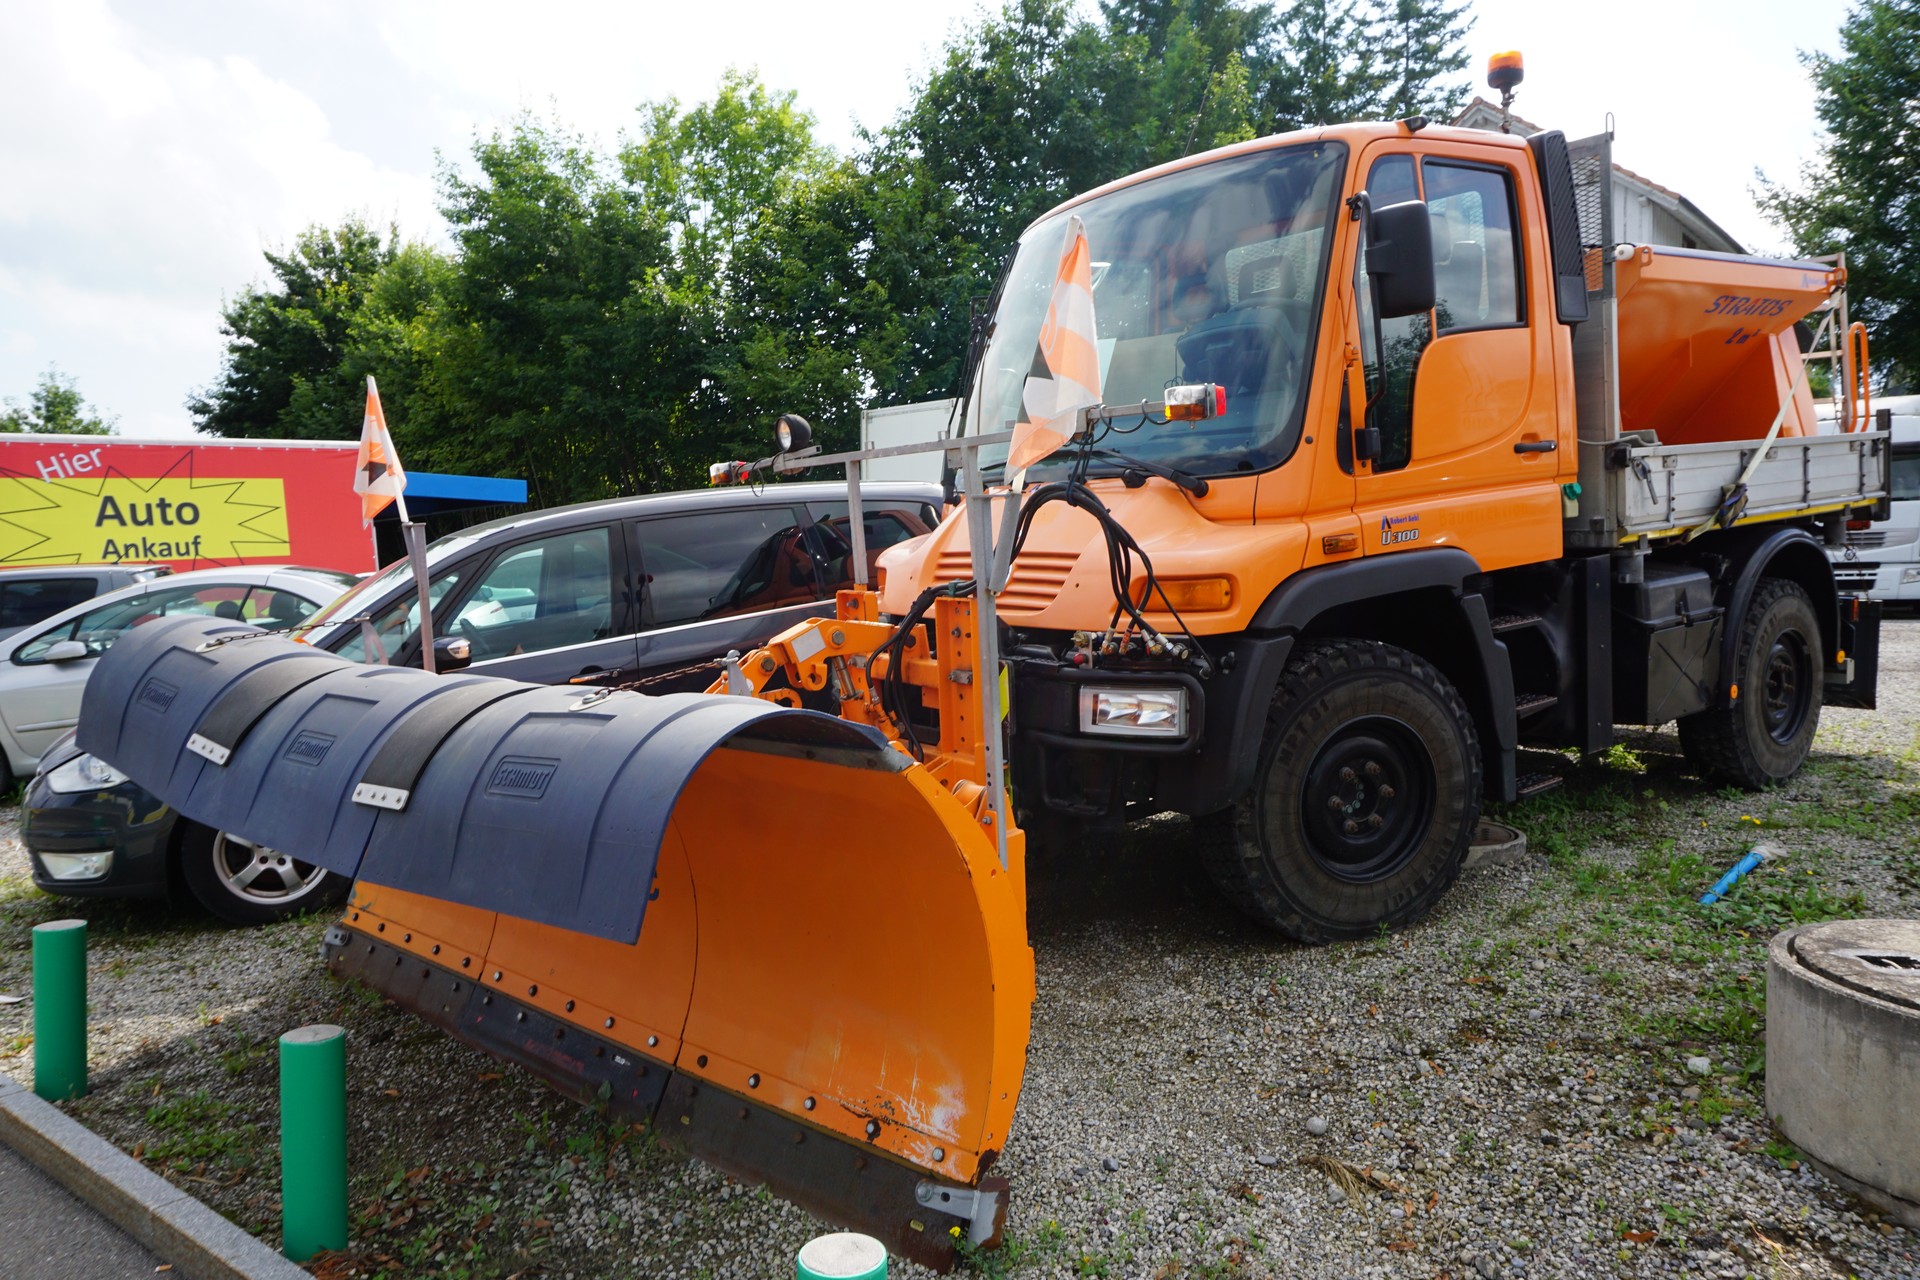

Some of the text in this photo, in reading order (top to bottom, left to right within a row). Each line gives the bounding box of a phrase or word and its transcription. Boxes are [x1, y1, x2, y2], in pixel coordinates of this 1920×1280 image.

[1704, 295, 1793, 317] STRATOS
[36, 447, 103, 484] Hier
[94, 495, 201, 528] Auto
[101, 535, 202, 560] Ankauf
[494, 767, 552, 790] SCHMIDT
